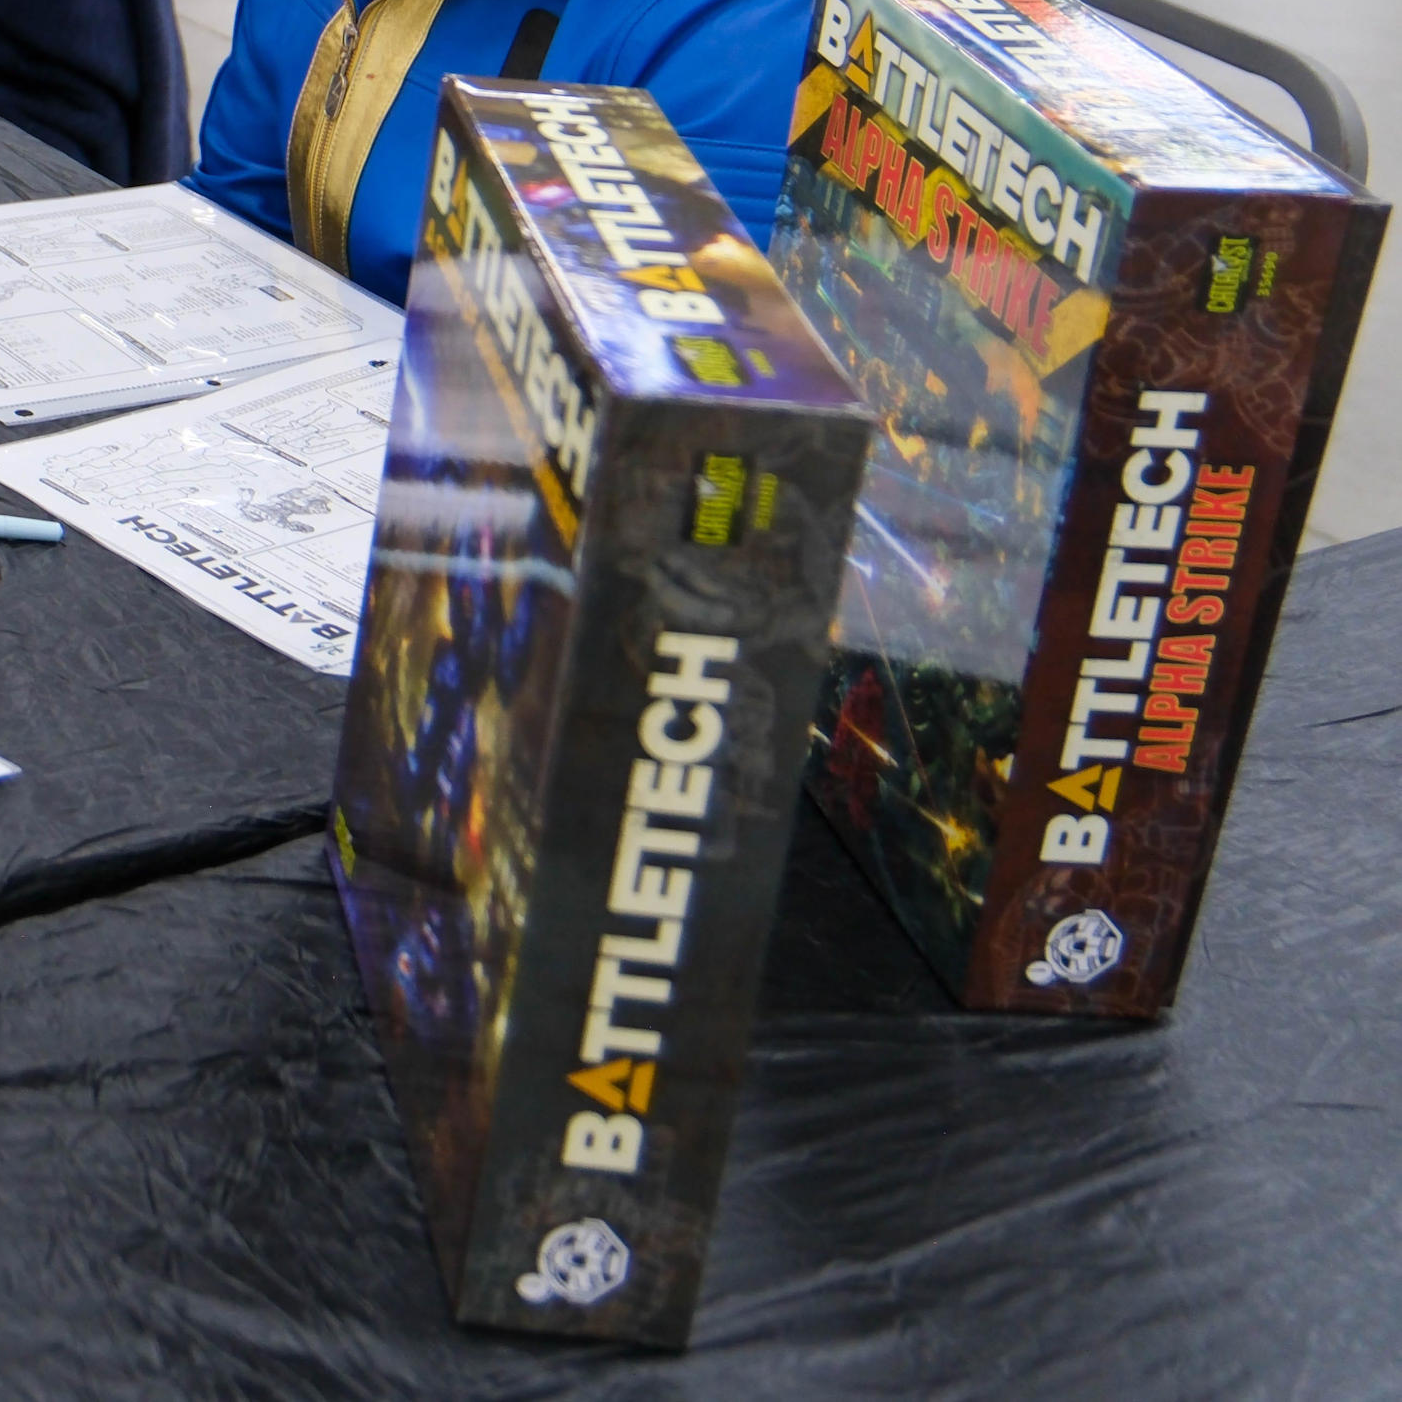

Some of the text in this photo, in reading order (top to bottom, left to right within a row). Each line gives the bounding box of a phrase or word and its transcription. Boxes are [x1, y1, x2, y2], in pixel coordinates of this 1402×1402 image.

[431, 127, 595, 498] BATTLETECH
[523, 99, 725, 325] BATTLETECH
[820, 95, 1061, 360] ALPHA STRIKE
[115, 515, 352, 640] BATTLETECH
[1040, 389, 1208, 865] BATTLETECH
[1132, 463, 1256, 774] ALPHA STRIKE
[562, 631, 740, 1174] BATTLETECH
